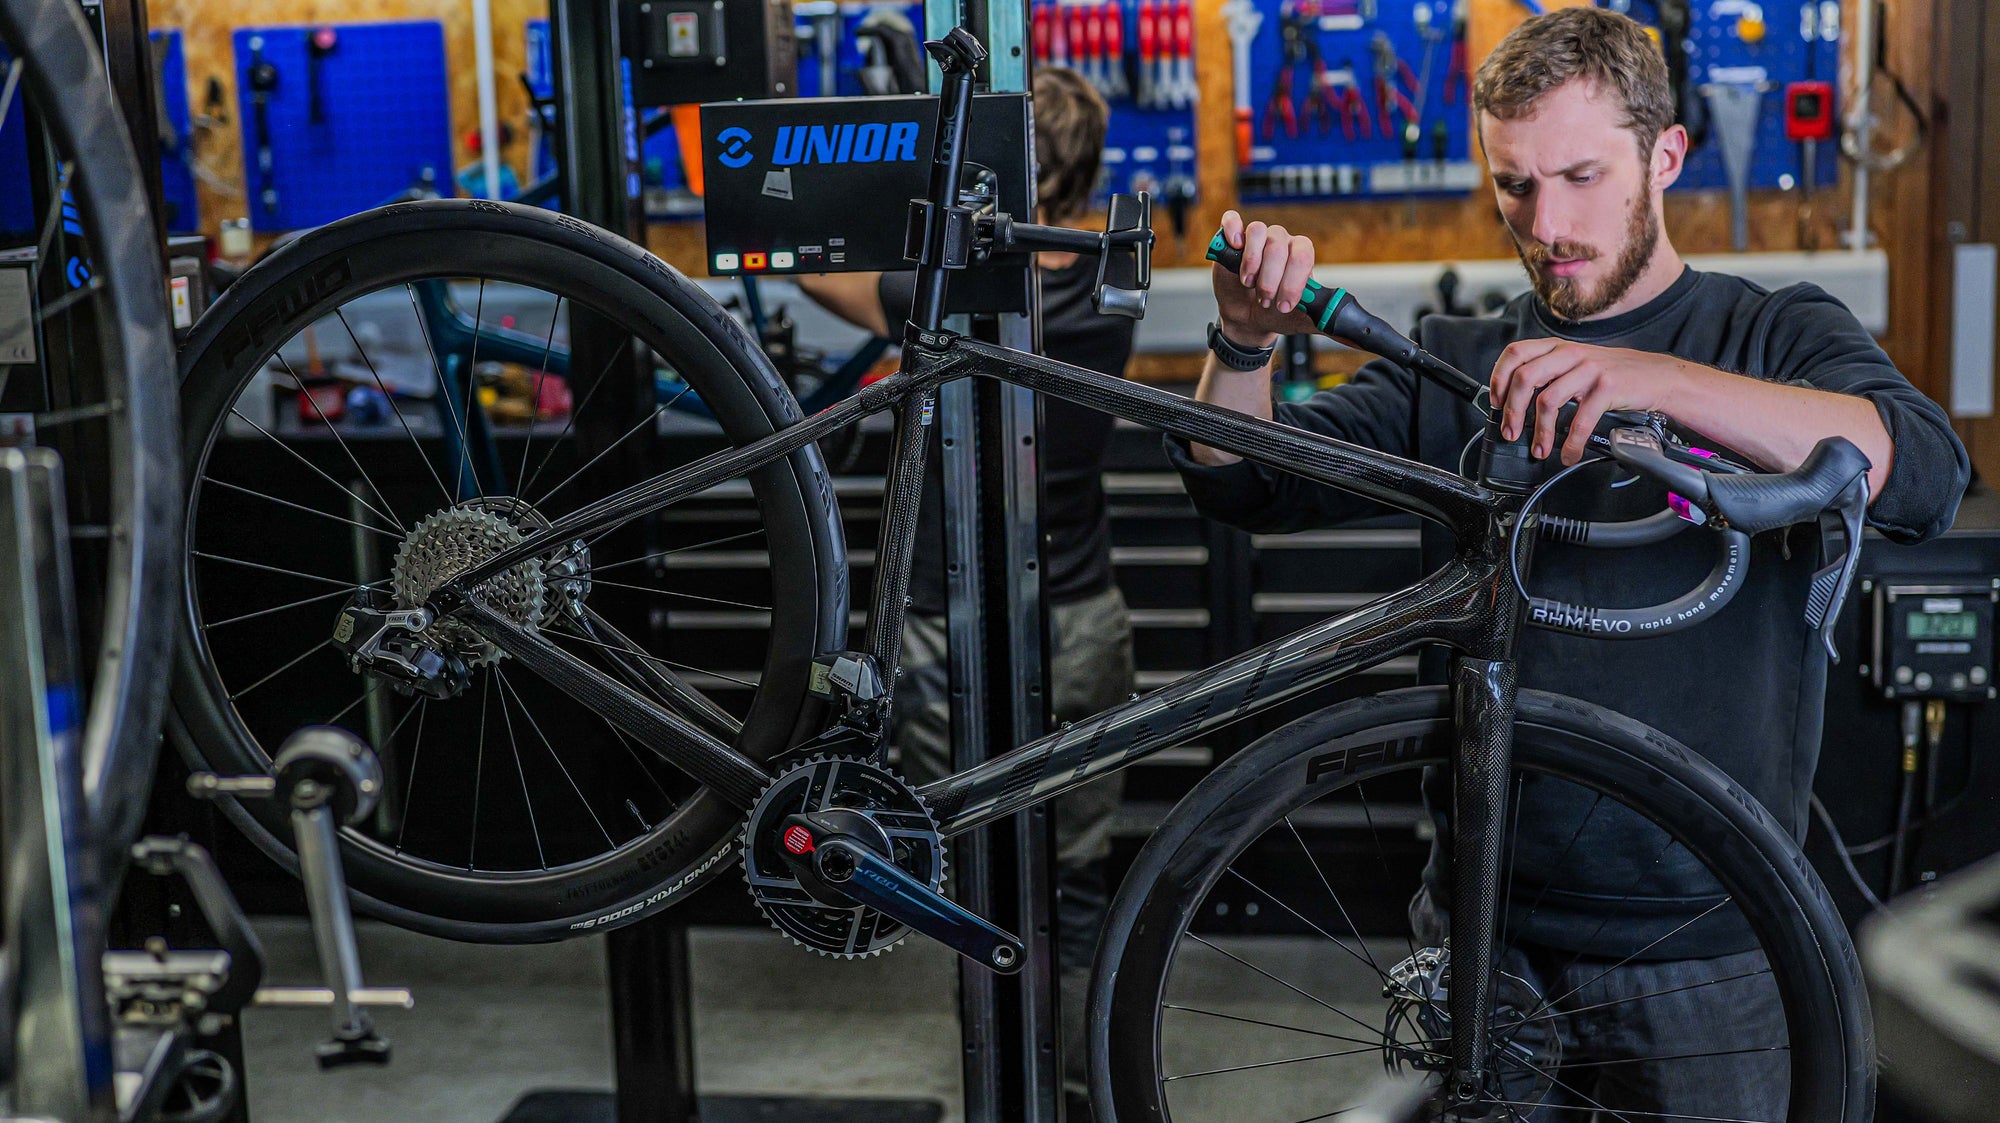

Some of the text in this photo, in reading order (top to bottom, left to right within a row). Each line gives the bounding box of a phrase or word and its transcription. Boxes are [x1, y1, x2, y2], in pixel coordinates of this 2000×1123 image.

[771, 121, 920, 165] UNIOR
[1533, 544, 1738, 632] RHM-EVO rapid hand movement
[684, 841, 731, 886] GRAND
[597, 901, 645, 925] 5000
[646, 880, 683, 906] PRIX
